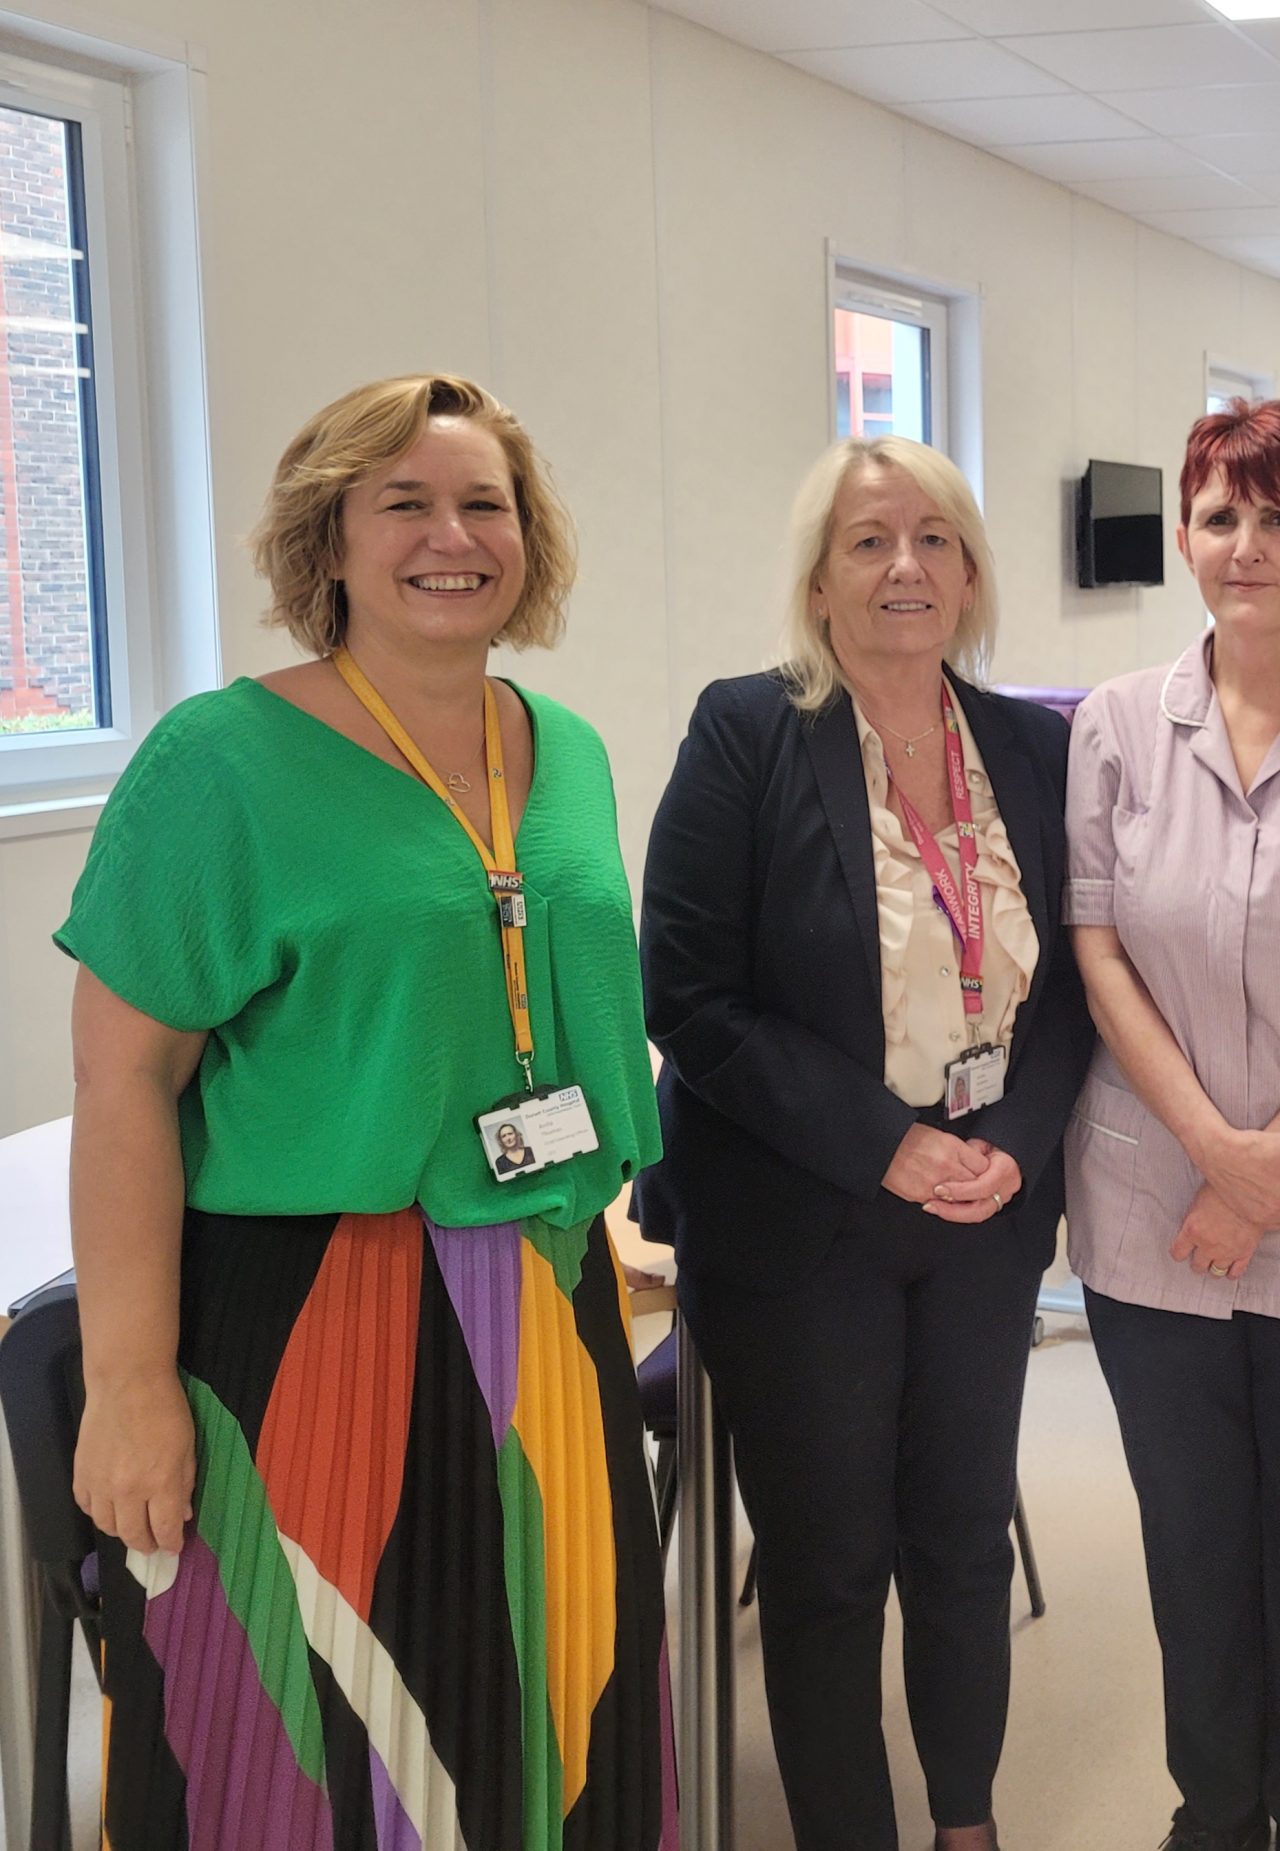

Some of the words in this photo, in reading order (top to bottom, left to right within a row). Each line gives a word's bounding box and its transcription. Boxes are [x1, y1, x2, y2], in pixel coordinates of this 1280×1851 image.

[951, 750, 965, 800] RESPECT
[490, 872, 520, 889] NHS
[965, 861, 981, 940] INTEGRITY
[961, 976, 980, 989] NHS
